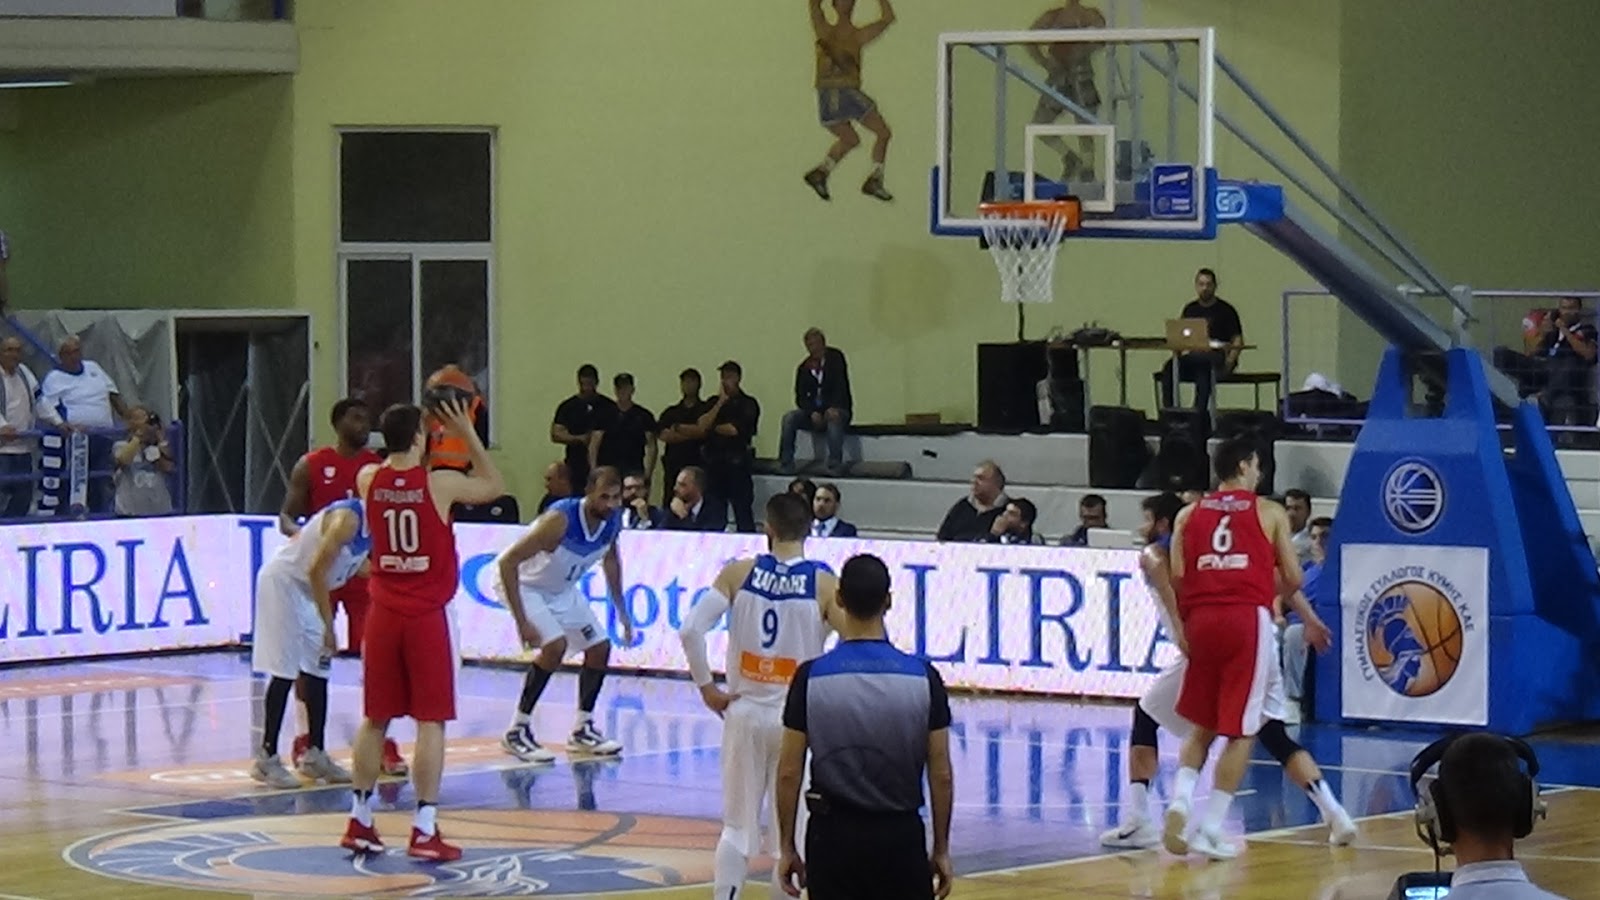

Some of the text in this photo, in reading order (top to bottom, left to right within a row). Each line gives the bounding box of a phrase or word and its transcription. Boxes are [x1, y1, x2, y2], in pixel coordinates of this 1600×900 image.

[383, 508, 419, 553] 10
[1212, 515, 1233, 553] 6
[0, 537, 209, 639] IRIA
[761, 608, 778, 649] 9
[1458, 602, 1476, 633] ΚΑΕ
